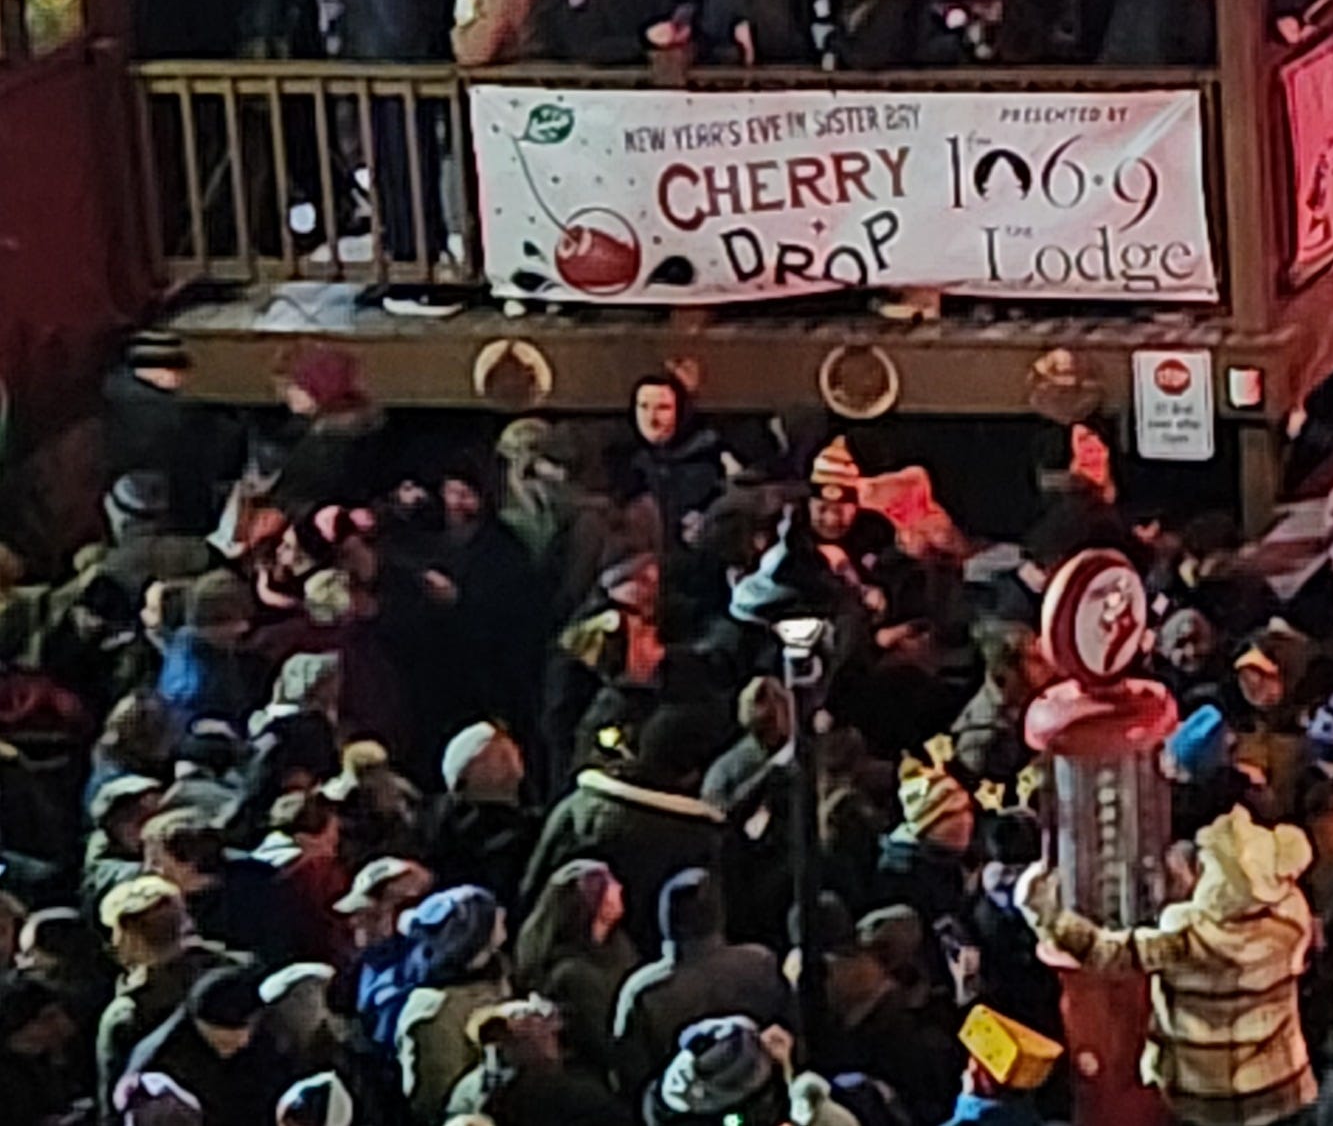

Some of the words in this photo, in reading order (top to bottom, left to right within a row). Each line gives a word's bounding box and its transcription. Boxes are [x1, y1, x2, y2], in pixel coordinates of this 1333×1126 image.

[624, 129, 665, 152] NEW
[747, 115, 782, 144] EVE
[814, 105, 879, 137] SISTER
[884, 103, 922, 130] BAY
[1000, 106, 1102, 123] PRESENTED
[1107, 106, 1129, 123] BY
[658, 147, 910, 231] CHERRY
[721, 210, 899, 286] DROP
[982, 225, 1194, 292] Lodge
